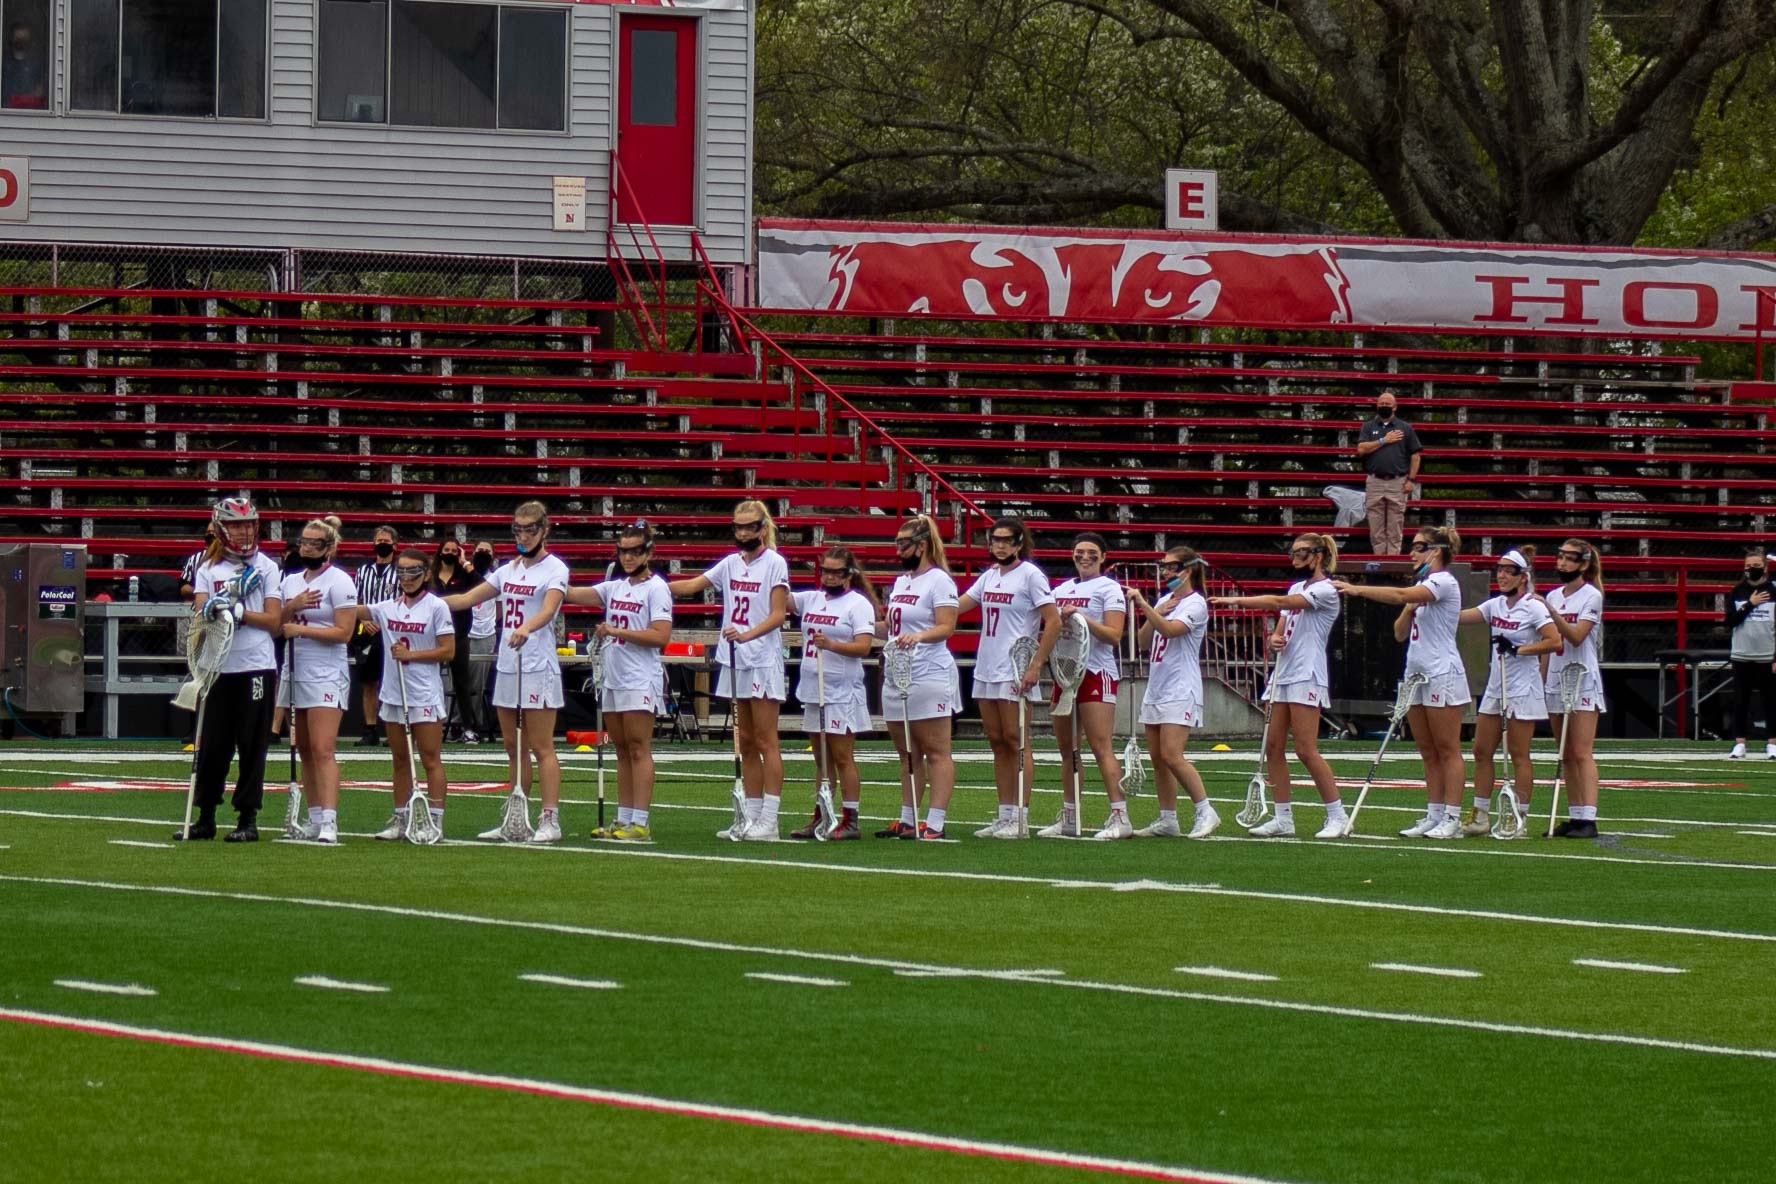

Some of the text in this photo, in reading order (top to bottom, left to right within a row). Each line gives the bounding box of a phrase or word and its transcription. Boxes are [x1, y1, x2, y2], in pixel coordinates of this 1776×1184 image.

[1179, 182, 1204, 219] E
[566, 214, 574, 223] N
[41, 591, 75, 600] PolarCool
[505, 598, 525, 629] 25
[732, 596, 750, 626] 22
[889, 607, 902, 637] 18
[986, 607, 1000, 637] 17
[806, 628, 822, 658] 2
[1152, 632, 1167, 662] 12
[252, 676, 263, 688] N
[252, 689, 263, 700] 20
[324, 693, 333, 702] N
[529, 694, 539, 703] N
[1431, 694, 1440, 703] N
[937, 704, 945, 712] N
[1582, 698, 1590, 707] N
[831, 720, 840, 729] N
